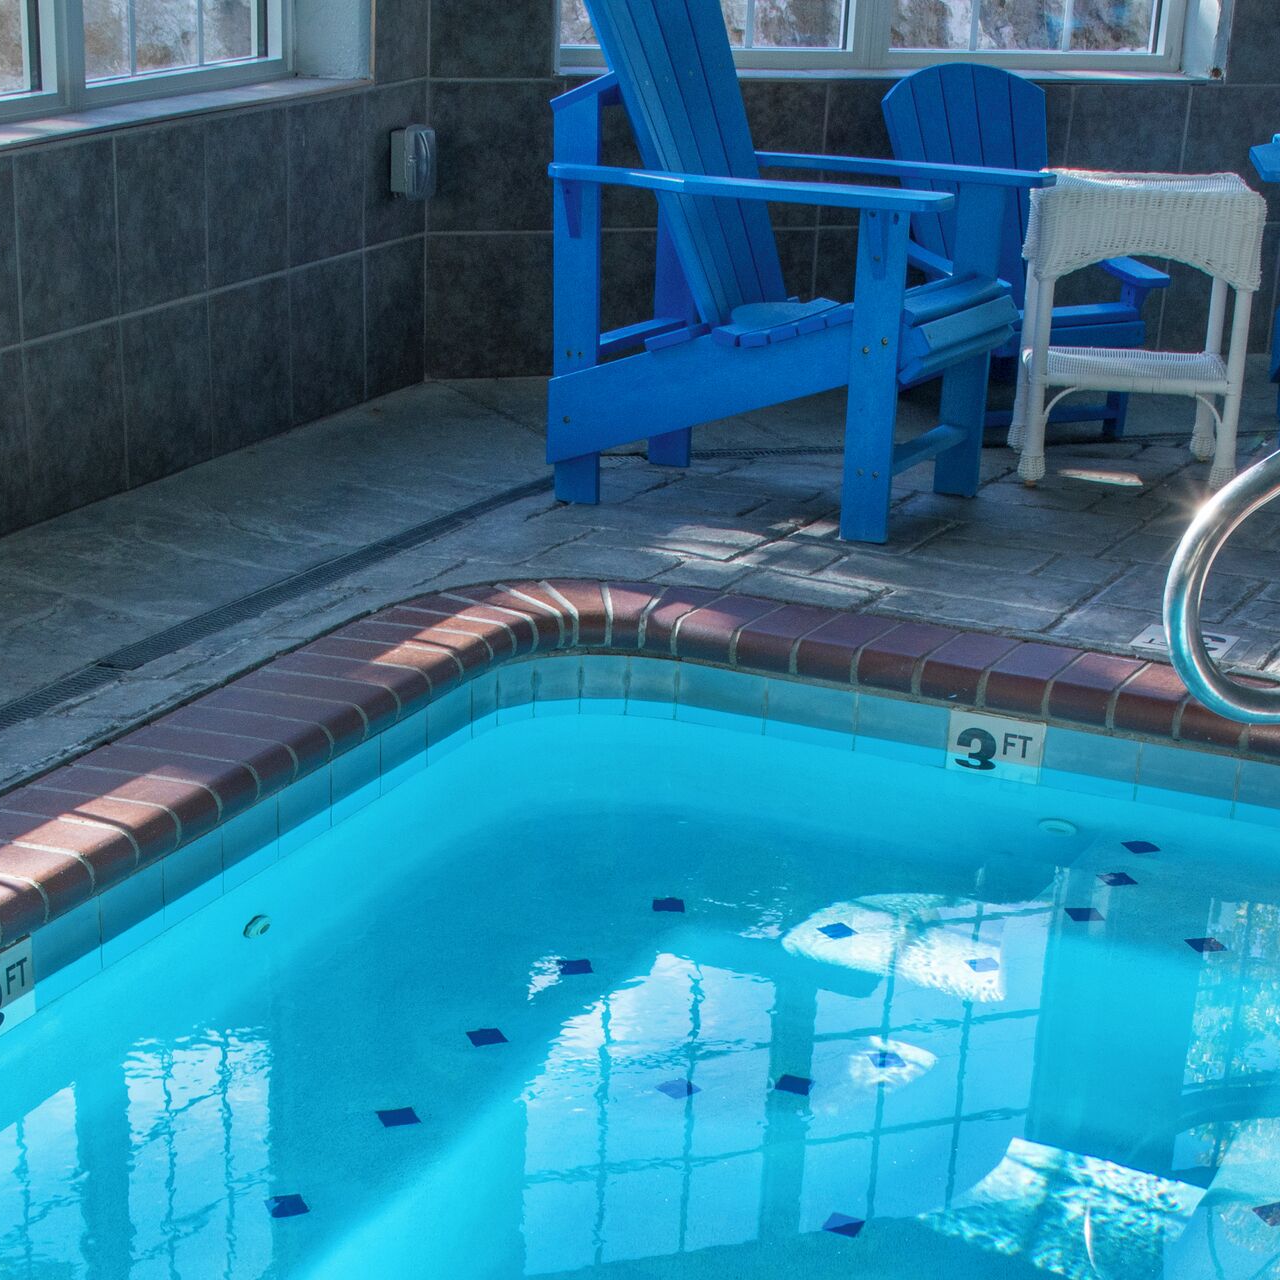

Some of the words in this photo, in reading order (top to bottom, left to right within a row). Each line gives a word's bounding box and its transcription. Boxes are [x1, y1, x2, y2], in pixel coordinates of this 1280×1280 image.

[954, 727, 997, 771] 3
[1002, 732, 1034, 759] FT
[5, 956, 28, 996] FT
